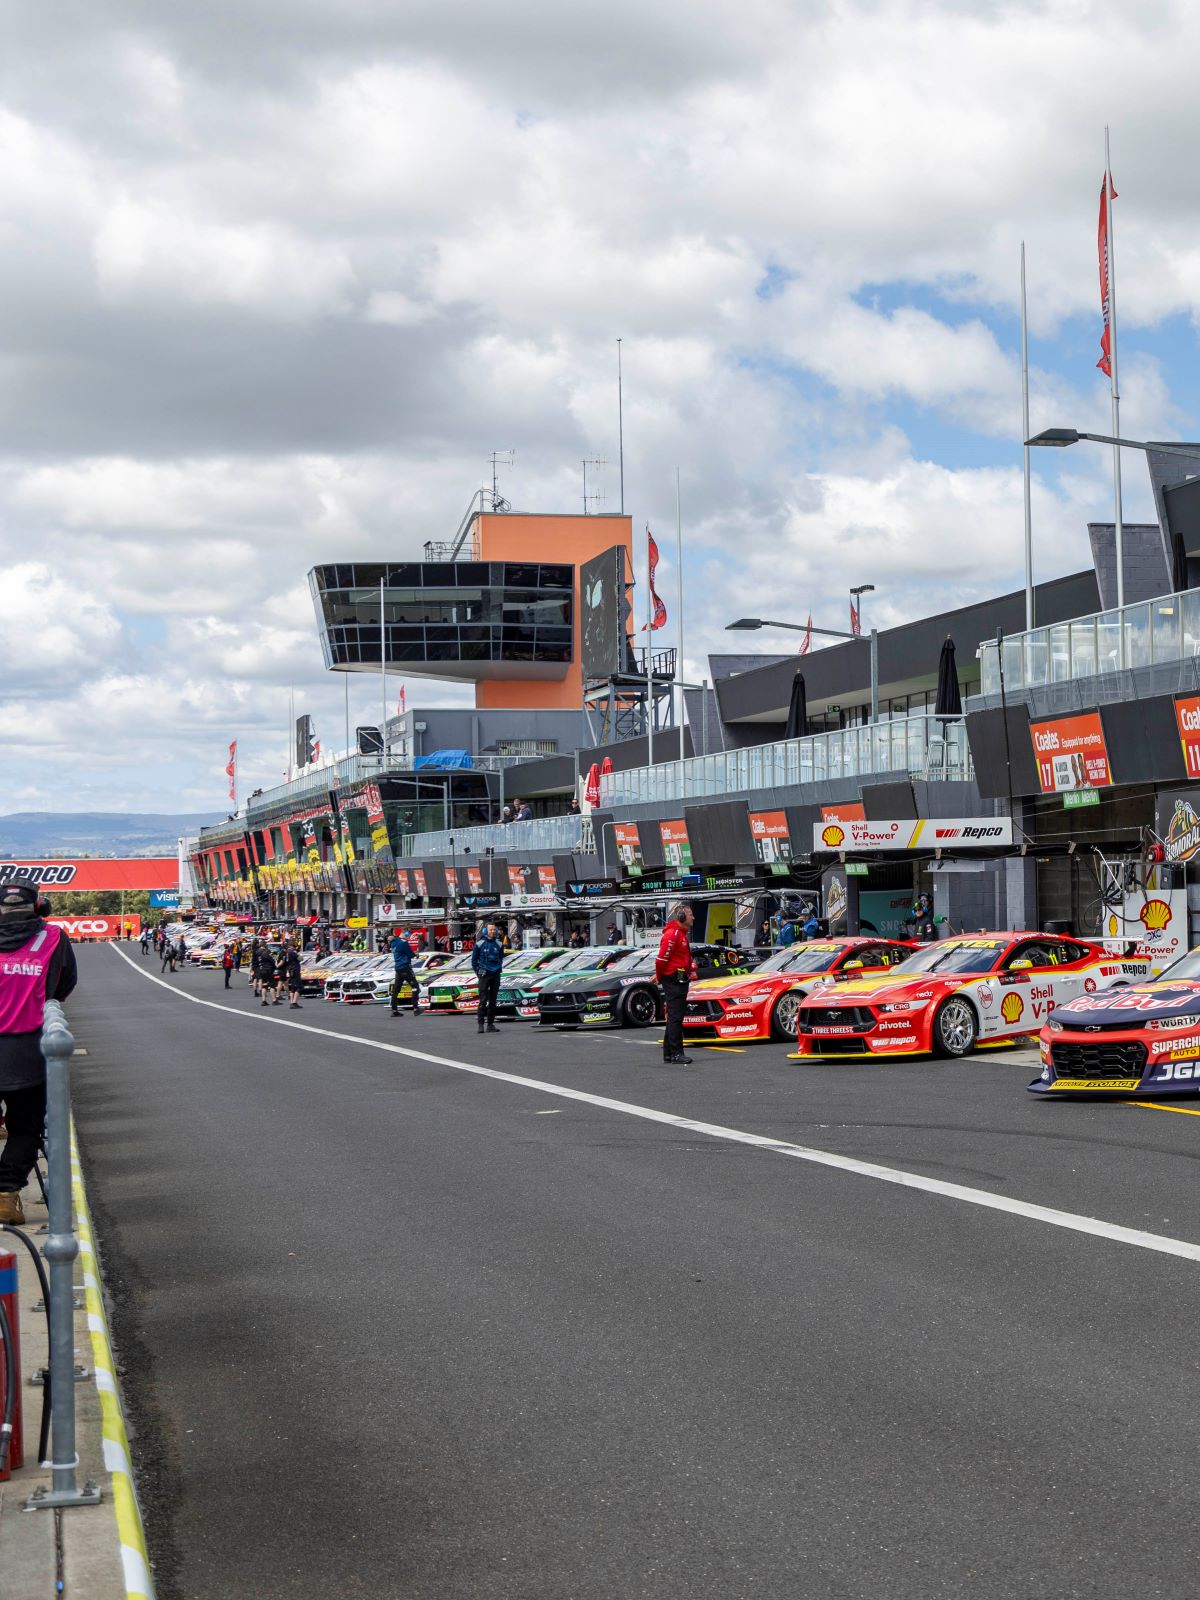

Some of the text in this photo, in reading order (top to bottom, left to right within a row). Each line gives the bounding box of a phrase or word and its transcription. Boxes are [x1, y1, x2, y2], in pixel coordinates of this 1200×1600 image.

[1034, 730, 1060, 752] Coates
[1041, 763, 1052, 787] 17
[851, 823, 868, 831] Shell
[851, 830, 896, 841] V-Power
[961, 826, 1003, 840] Repco
[0, 864, 77, 885] Repco
[642, 879, 684, 890] SNOWY RIVER
[715, 878, 744, 886] MONSTER
[529, 896, 556, 904] Castrol
[50, 919, 109, 934] YCO
[452, 940, 474, 951] 1926
[1135, 945, 1176, 954] V-Power
[1048, 953, 1059, 965] 11
[4, 962, 43, 977] LANE
[1121, 963, 1147, 976] Repco
[1030, 984, 1054, 1000] Shell
[520, 1006, 539, 1015] RYC
[879, 1020, 912, 1032] pivotel.
[1160, 1016, 1197, 1028] WÜRTH
[890, 1036, 917, 1045] Repco
[1173, 1049, 1198, 1057] AUTO
[1088, 1080, 1135, 1089] STORAGE
